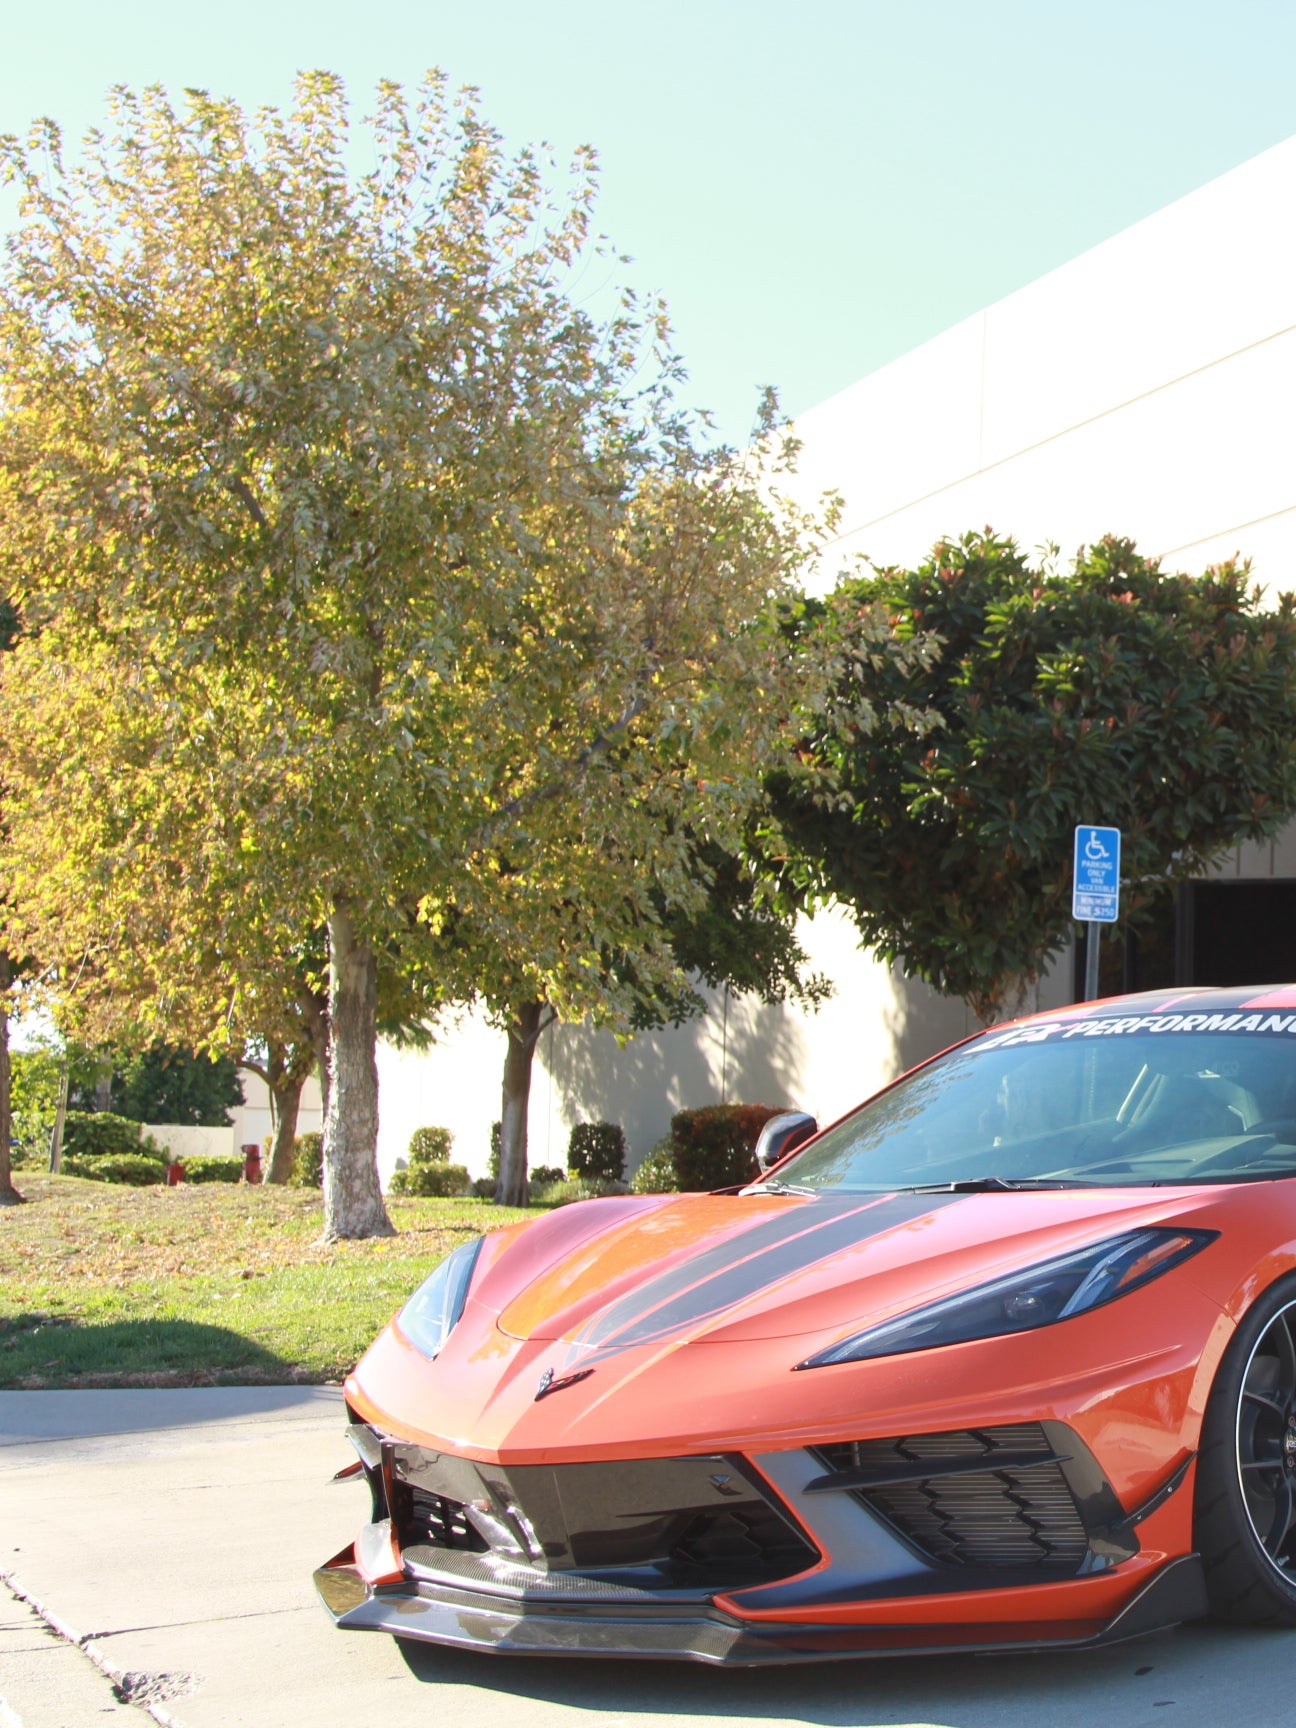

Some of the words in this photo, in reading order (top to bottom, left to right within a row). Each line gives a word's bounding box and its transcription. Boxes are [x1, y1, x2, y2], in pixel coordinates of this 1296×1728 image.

[1081, 860, 1113, 870] PARKING
[1087, 869, 1106, 877] ONLY
[1077, 883, 1115, 893] ACCESSIBLE
